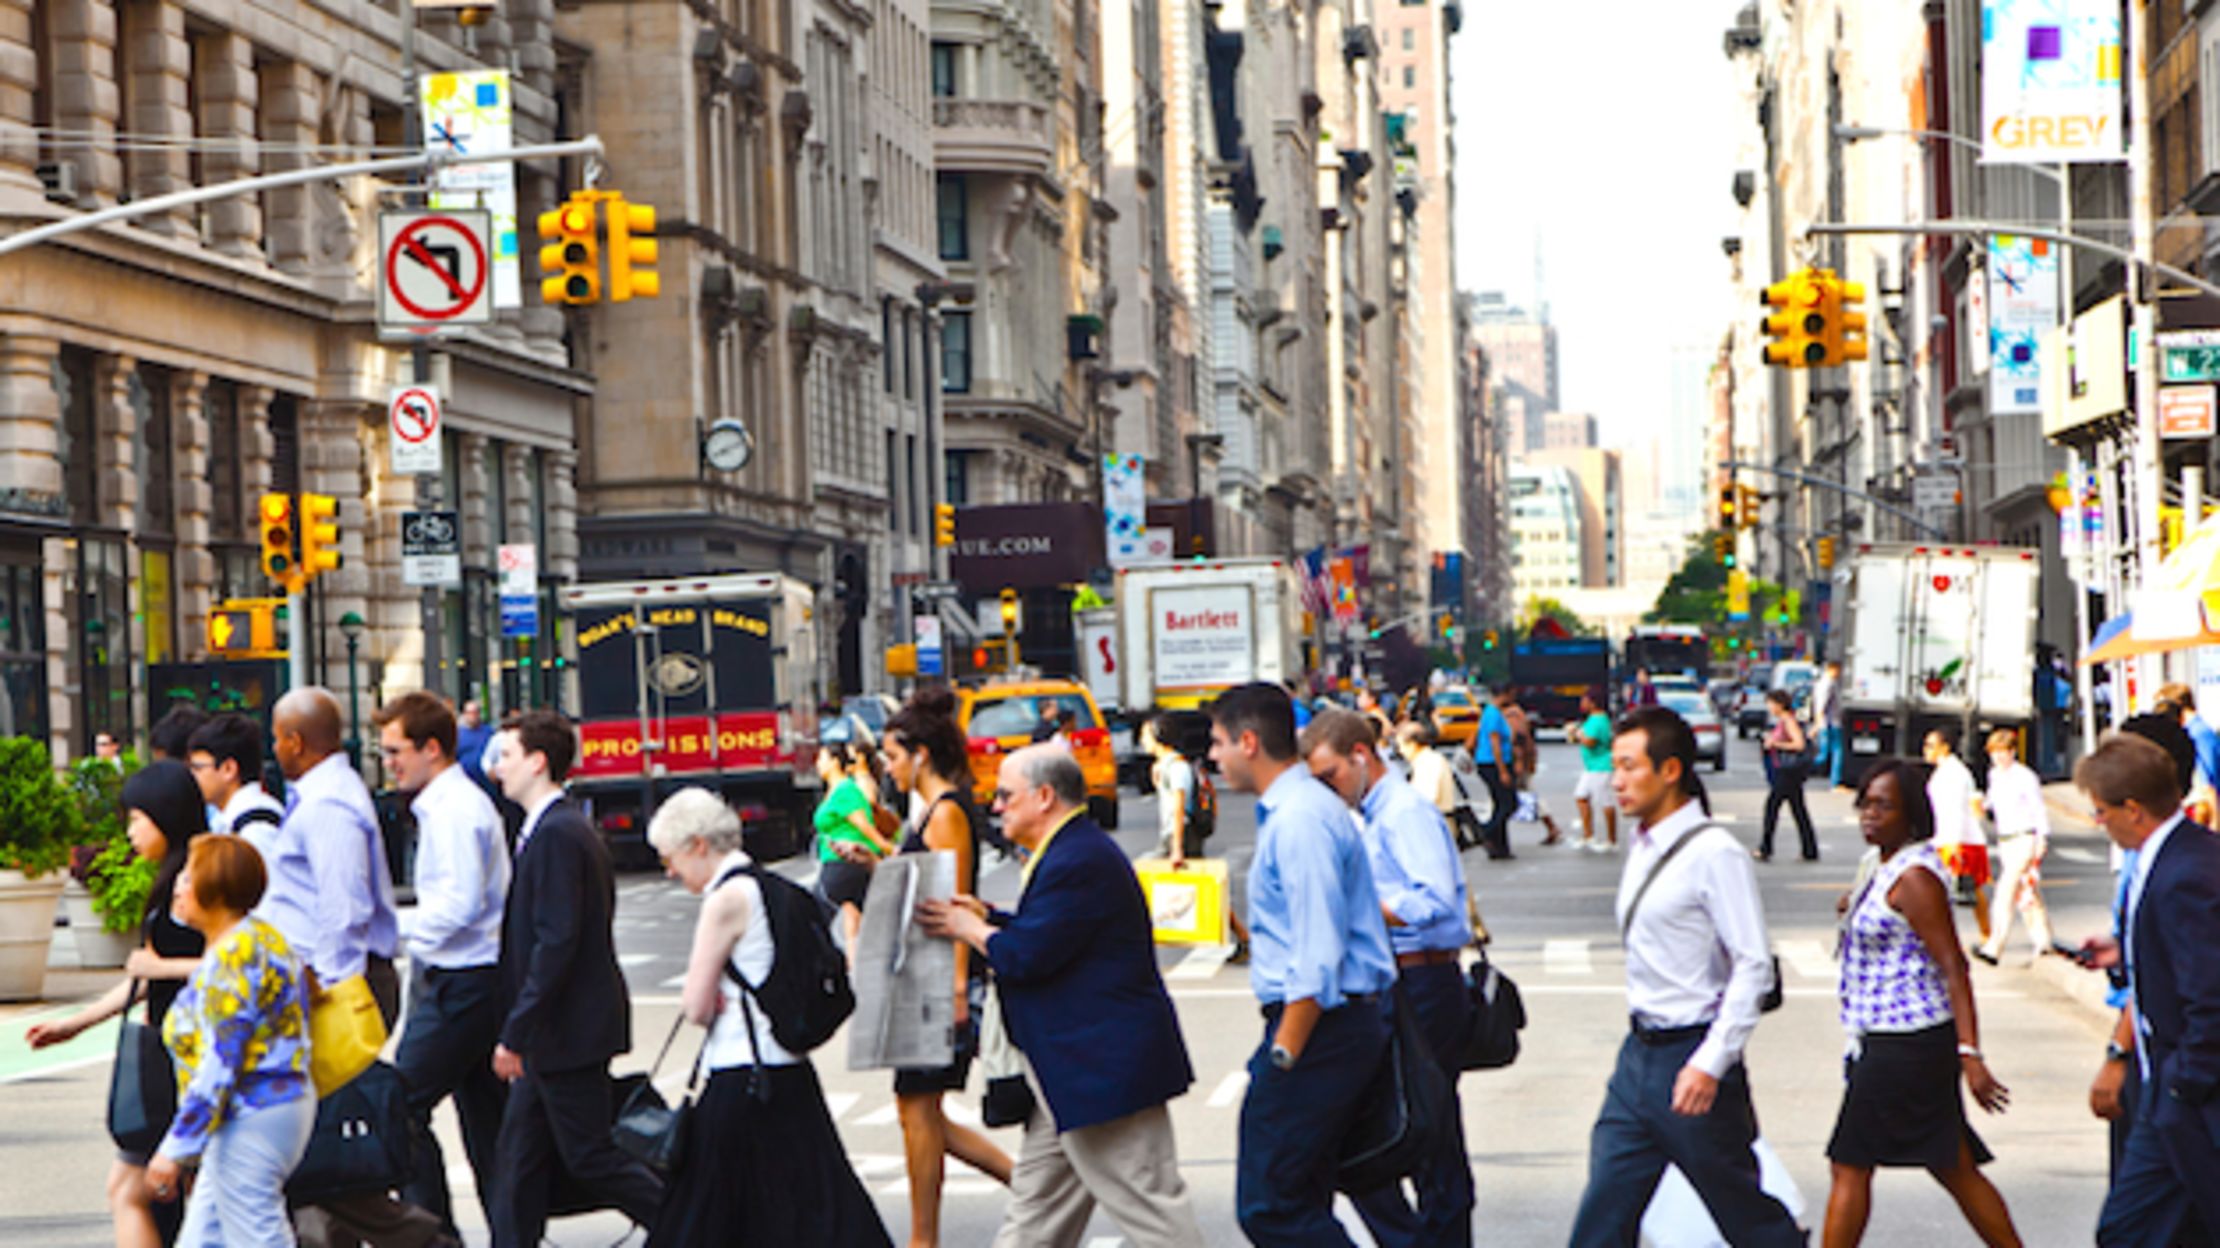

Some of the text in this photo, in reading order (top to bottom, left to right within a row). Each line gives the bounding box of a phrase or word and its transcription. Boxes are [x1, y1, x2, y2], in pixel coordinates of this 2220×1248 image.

[1991, 115, 2108, 148] GREY
[650, 608, 697, 625] HEAD
[713, 609, 769, 637] BRAND
[1165, 608, 1239, 631] Bartlett
[582, 728, 776, 757] PROISIONS
